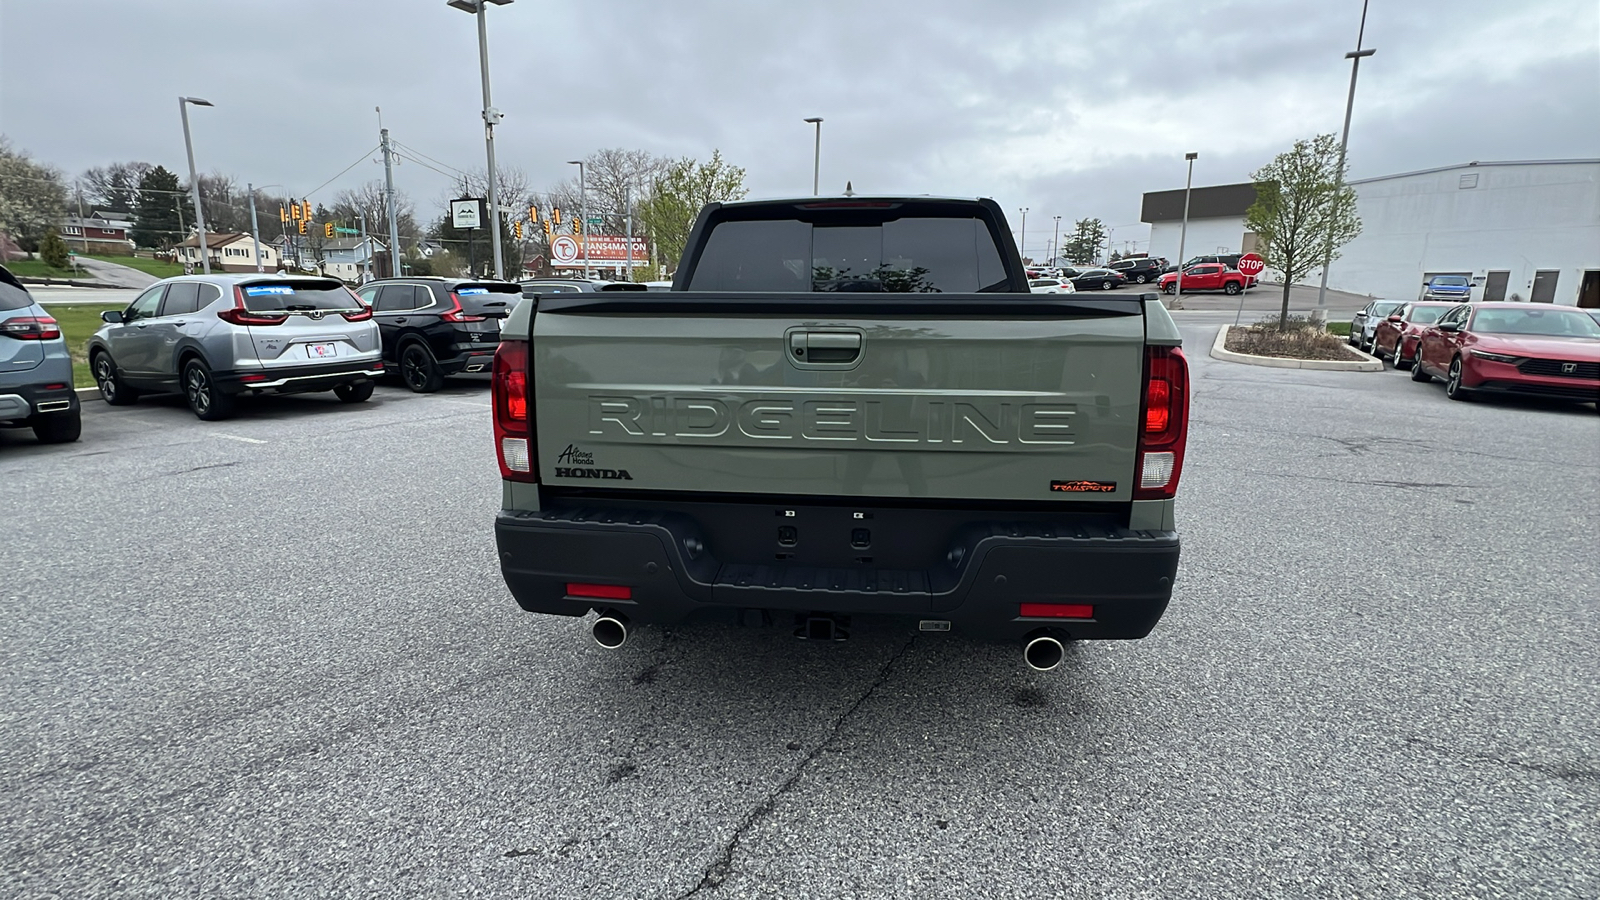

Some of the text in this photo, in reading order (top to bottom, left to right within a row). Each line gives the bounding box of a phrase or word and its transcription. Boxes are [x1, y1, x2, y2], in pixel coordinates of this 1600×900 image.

[1240, 259, 1263, 269] STOP
[588, 395, 1076, 444] RIDGELINE
[554, 466, 633, 480] HONDA
